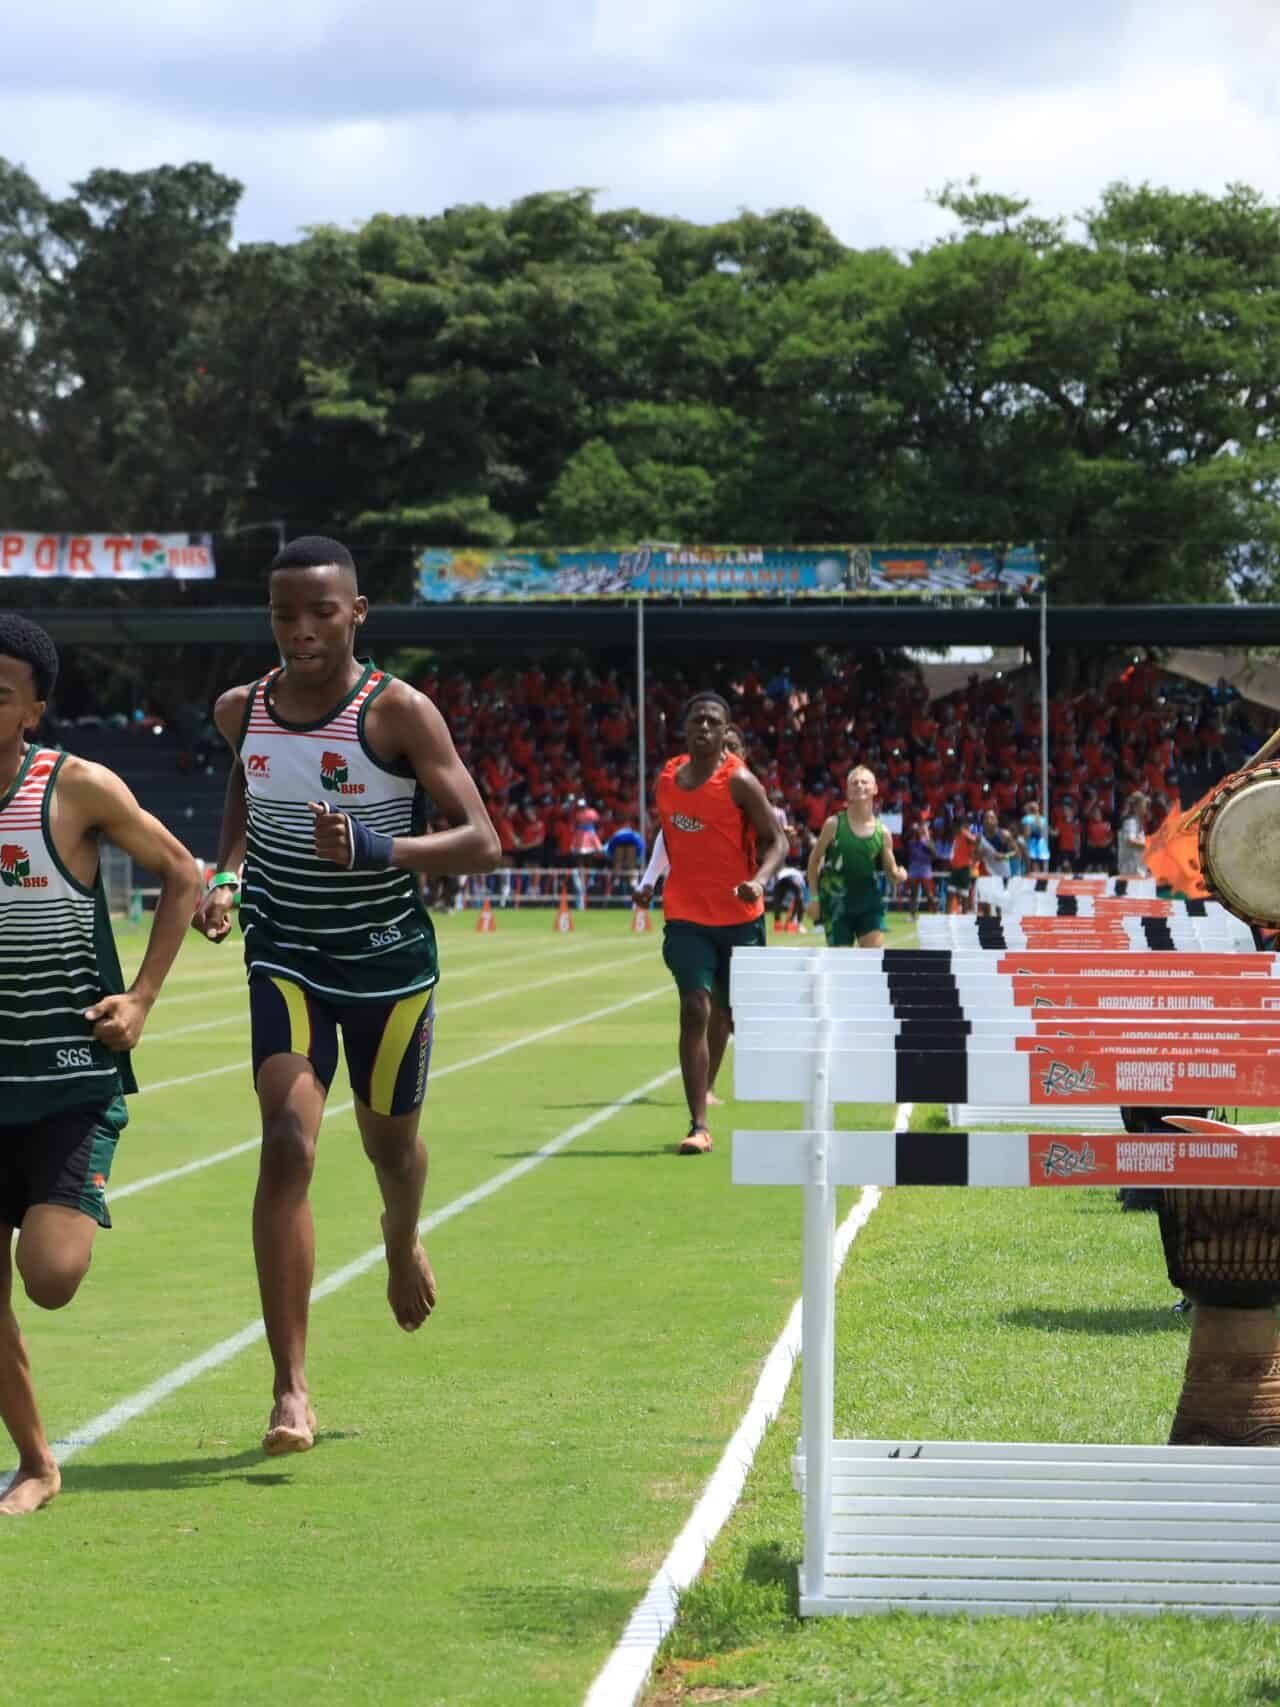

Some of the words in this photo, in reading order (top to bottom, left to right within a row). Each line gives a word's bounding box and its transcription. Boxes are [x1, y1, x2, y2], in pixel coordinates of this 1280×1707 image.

[341, 783, 365, 794] BHS
[23, 876, 48, 888] BHS
[369, 925, 401, 948] SGS
[56, 1048, 92, 1068] SGS
[1116, 1062, 1175, 1077] HARDWARE
[1187, 1063, 1237, 1078] BUILDING
[1116, 1077, 1174, 1092] MATERIALS
[1117, 1142, 1176, 1158] HARDWARE
[1189, 1143, 1238, 1158] BUILDING
[1117, 1158, 1175, 1173] MATERIALS
